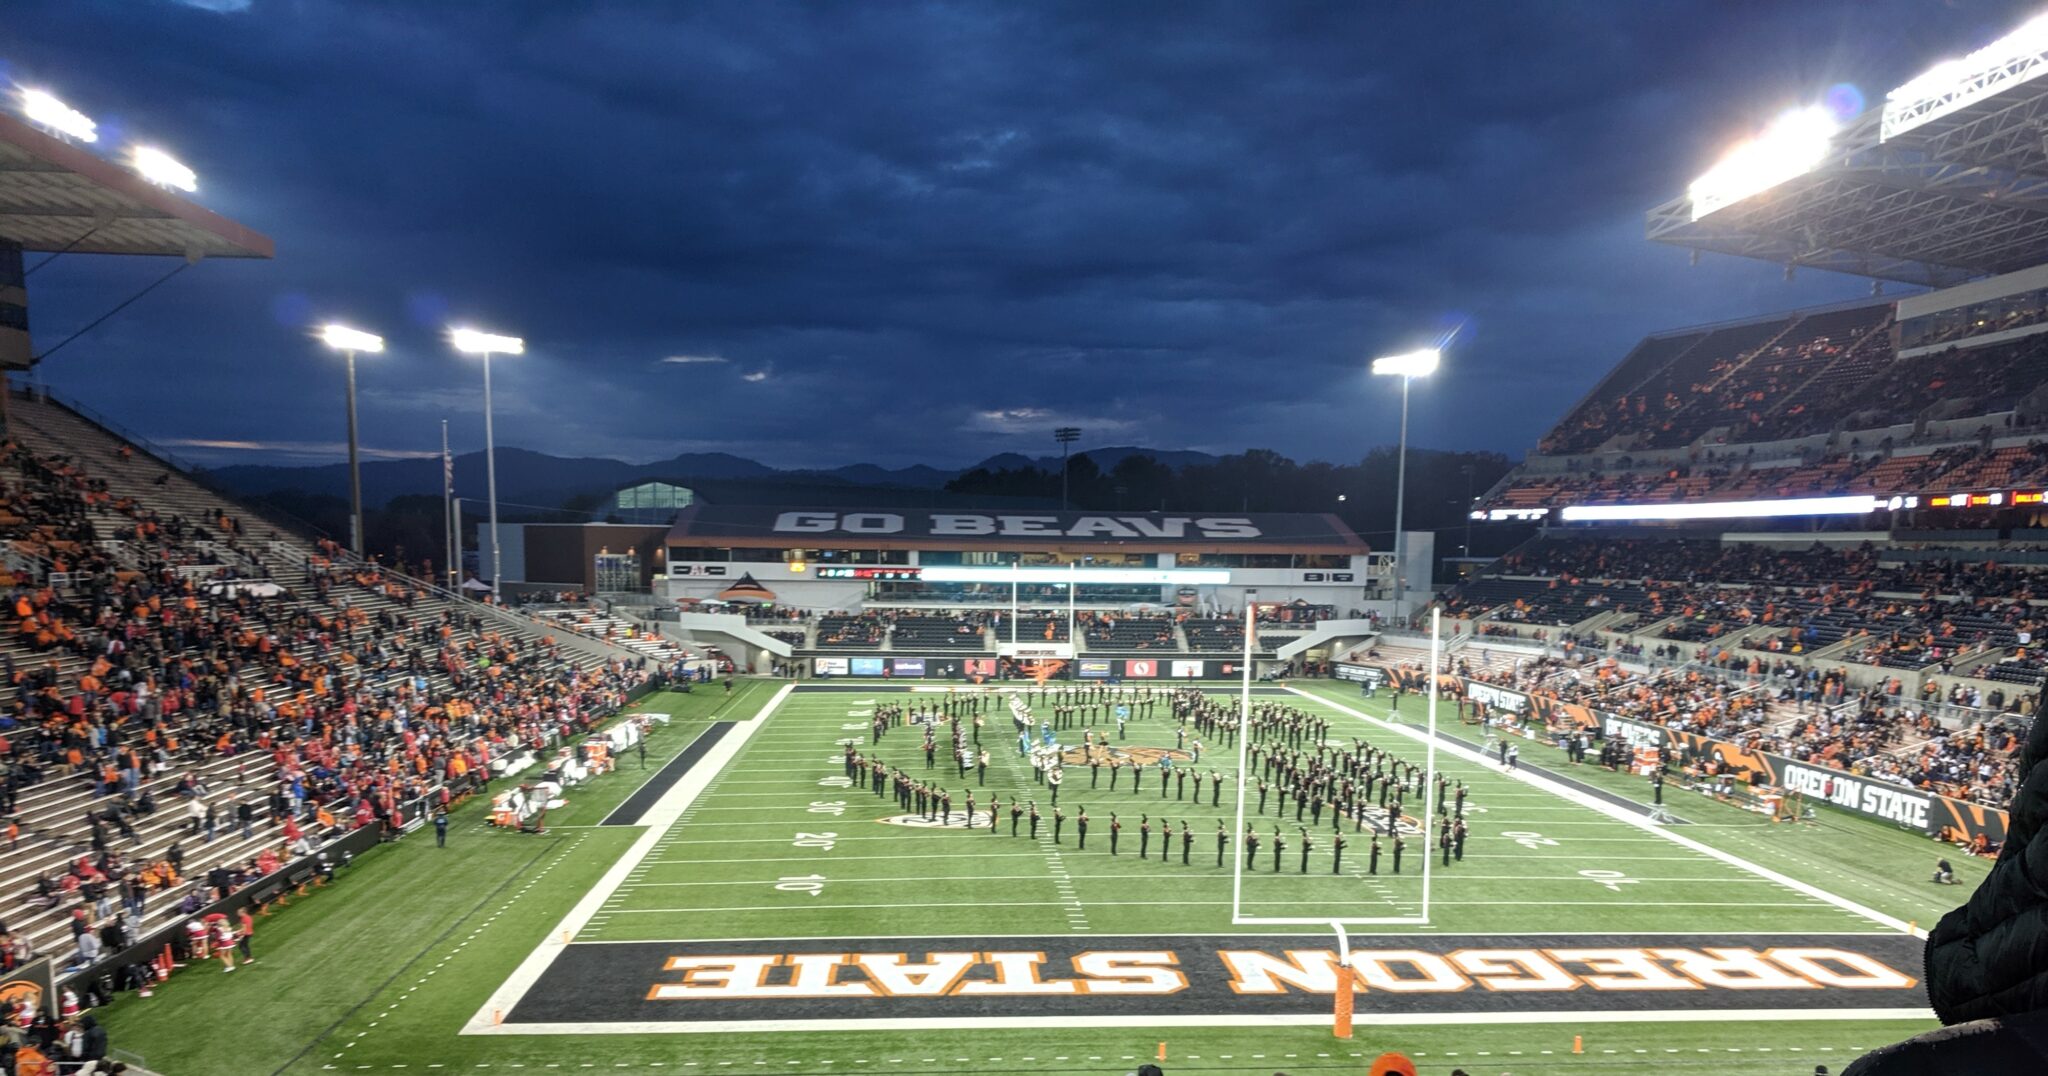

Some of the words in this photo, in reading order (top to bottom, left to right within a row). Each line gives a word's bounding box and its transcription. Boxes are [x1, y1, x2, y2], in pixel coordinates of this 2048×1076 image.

[773, 511, 904, 533] GO
[929, 513, 1262, 539] BEAVS
[807, 801, 847, 814] 30
[1862, 784, 1930, 829] STATE
[792, 832, 838, 847] 20
[1502, 831, 1560, 846] 20
[774, 874, 827, 891] 10
[1577, 869, 1641, 884] 10
[647, 950, 1190, 1001] STATE
[1217, 948, 1918, 995] OREGON
